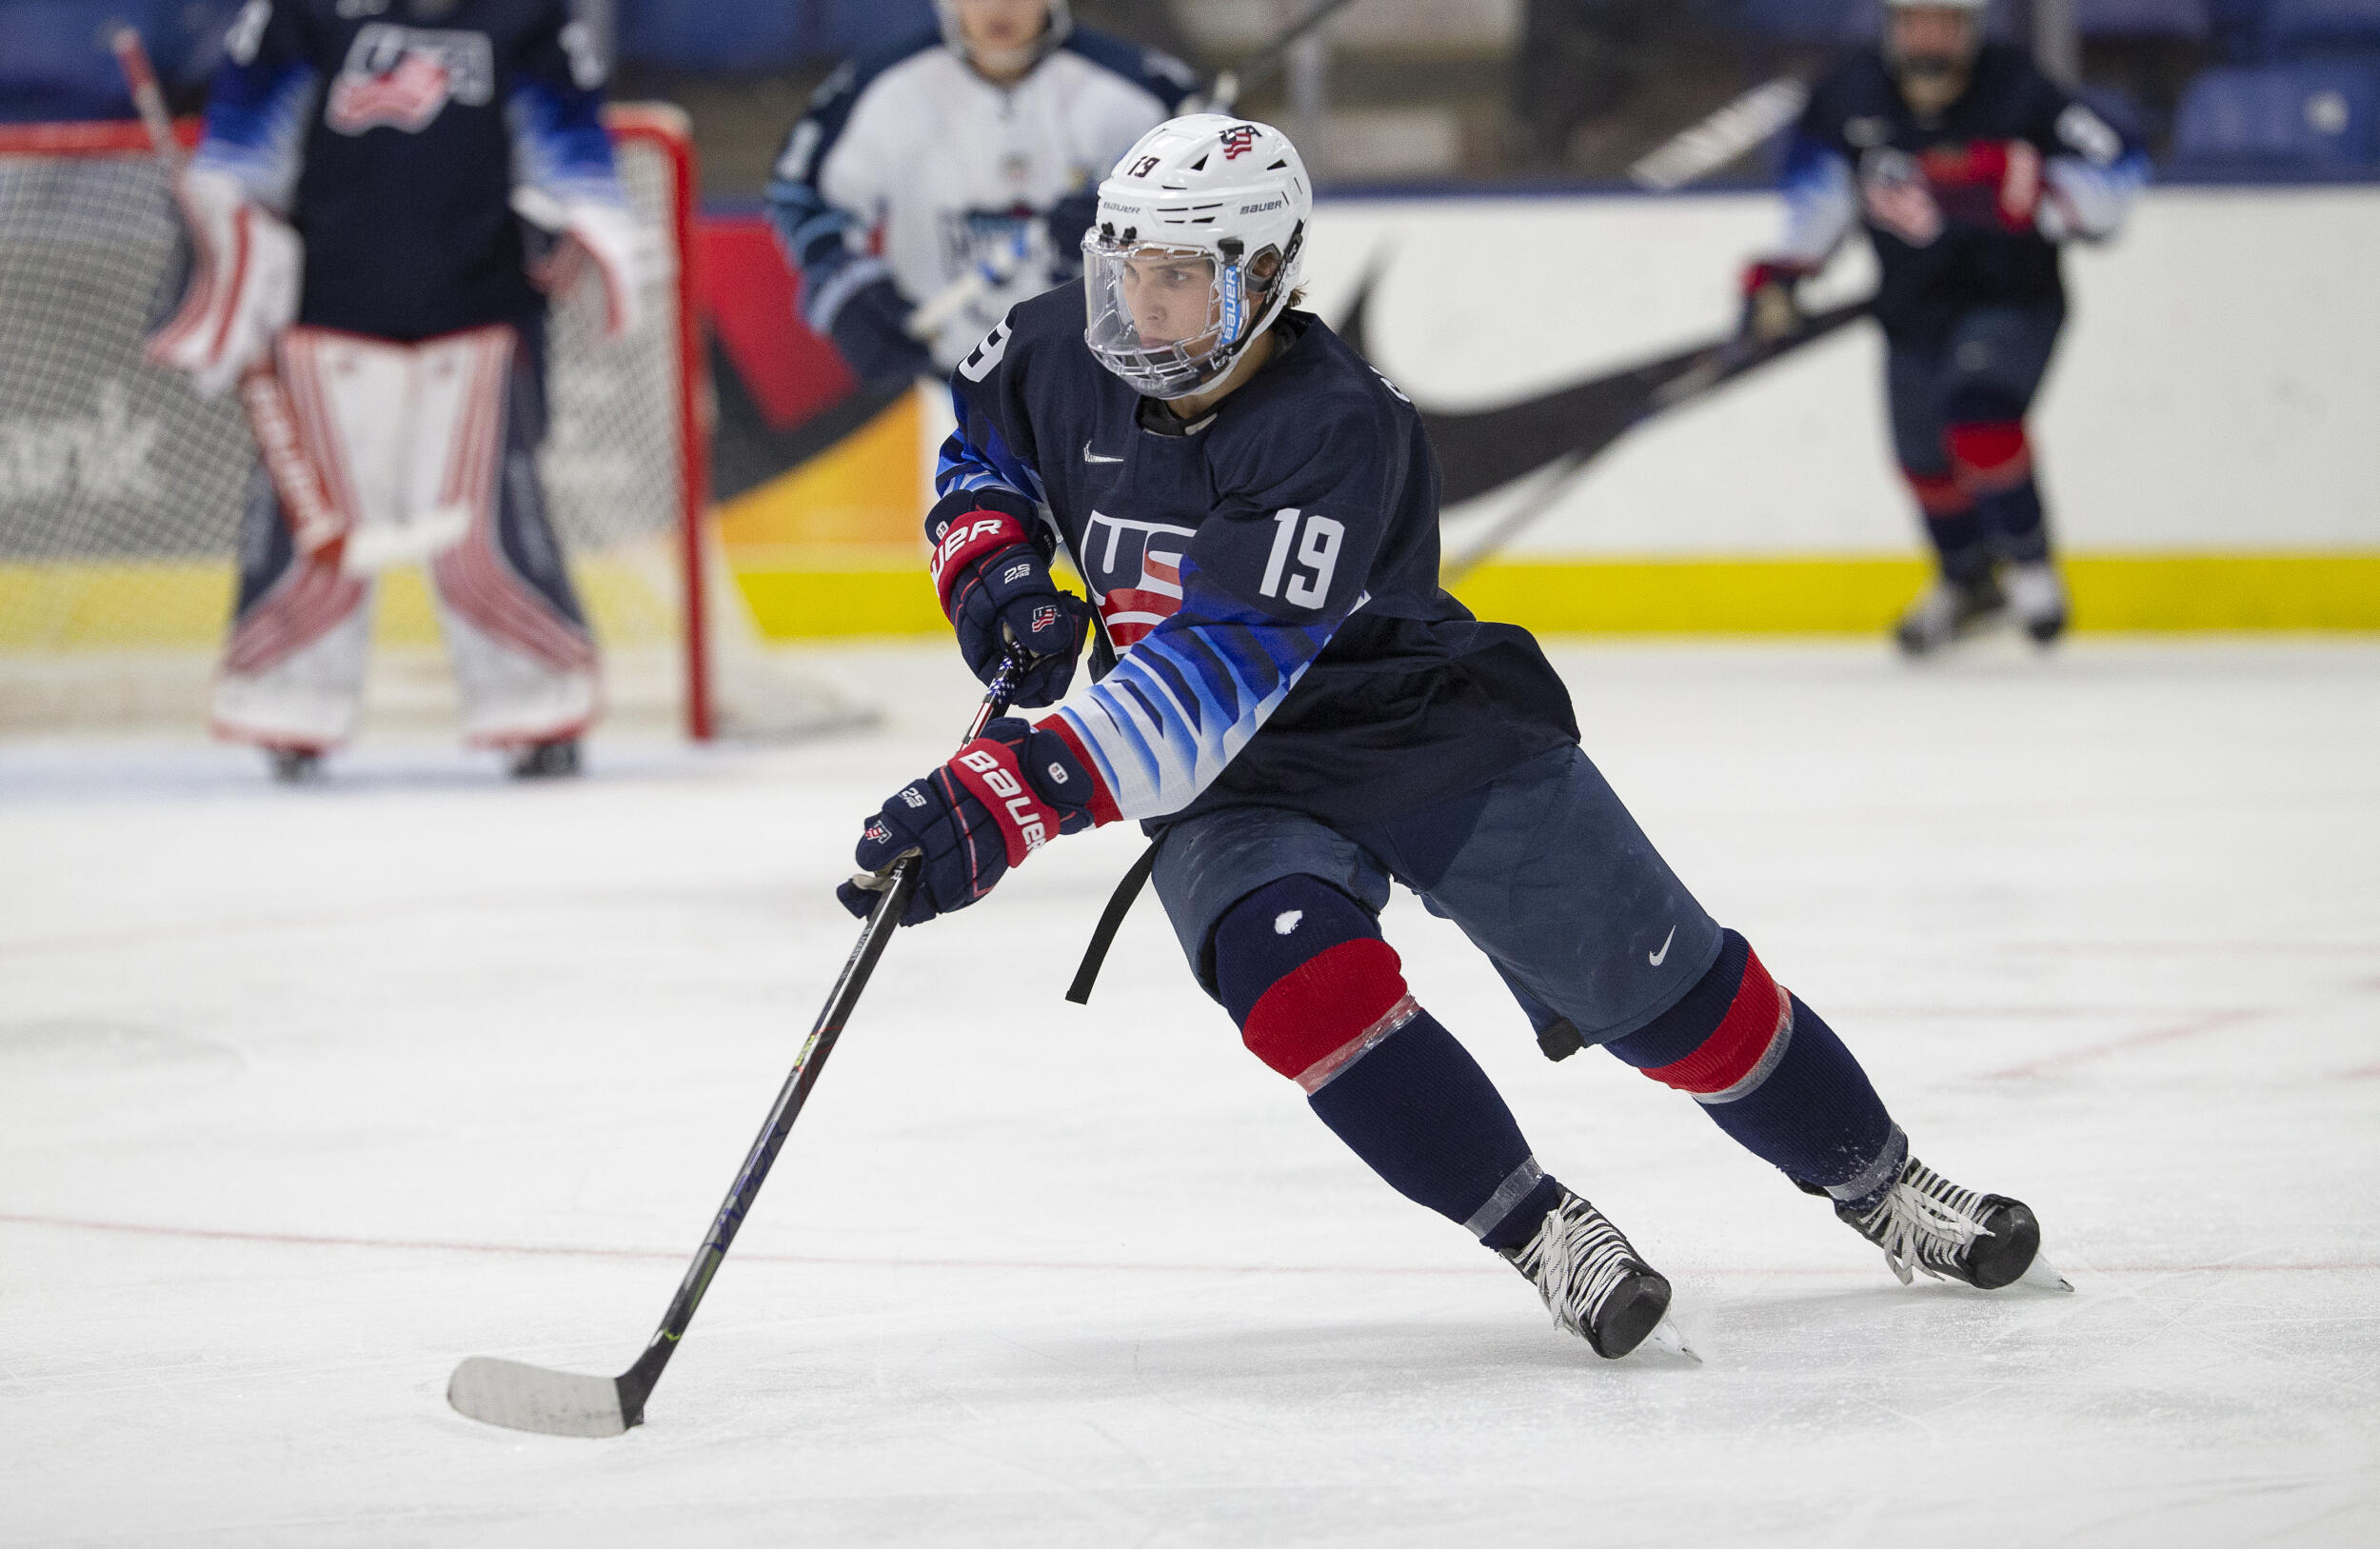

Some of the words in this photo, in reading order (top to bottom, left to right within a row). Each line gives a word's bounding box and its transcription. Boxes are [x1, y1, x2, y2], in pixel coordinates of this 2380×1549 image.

[1127, 155, 1160, 178] 19
[1103, 201, 1140, 215] BAUER
[1240, 200, 1282, 215] BAUER
[1223, 268, 1237, 342] BAUER
[930, 519, 1002, 599] UER
[1259, 507, 1345, 609] 19
